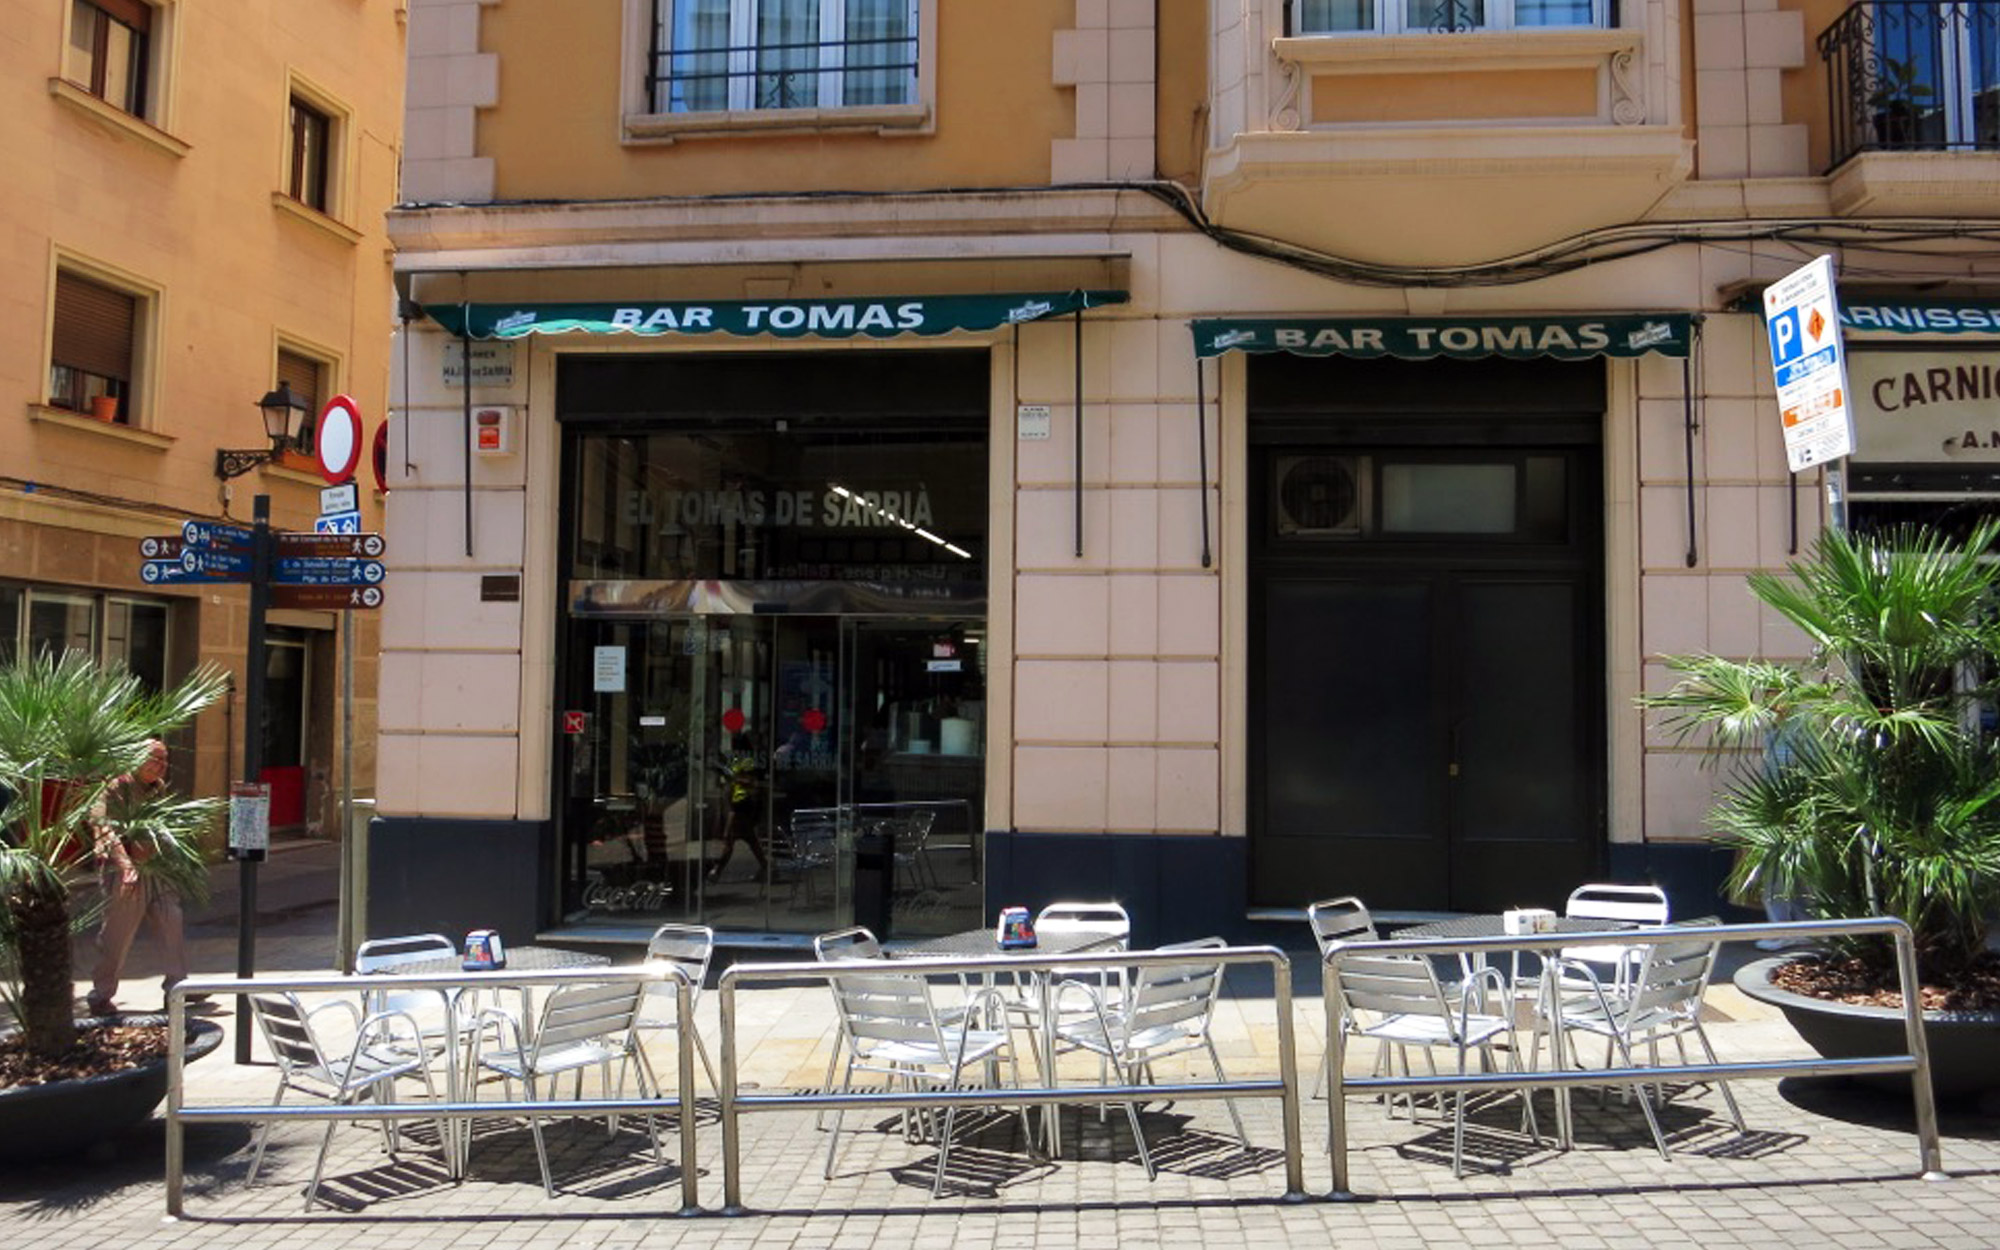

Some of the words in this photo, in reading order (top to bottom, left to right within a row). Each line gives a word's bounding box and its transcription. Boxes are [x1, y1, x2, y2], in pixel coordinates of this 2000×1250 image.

[610, 307, 713, 329] BAR
[742, 302, 924, 330] TOMAS
[1838, 306, 2000, 328] RNISS
[1275, 328, 1386, 350] BAR
[1406, 323, 1610, 350] TOMAS
[1776, 314, 1794, 360] P
[1872, 365, 2000, 412] CARNI
[622, 490, 655, 525] EL
[775, 490, 814, 526] DE
[823, 482, 933, 527] SARRIÀ
